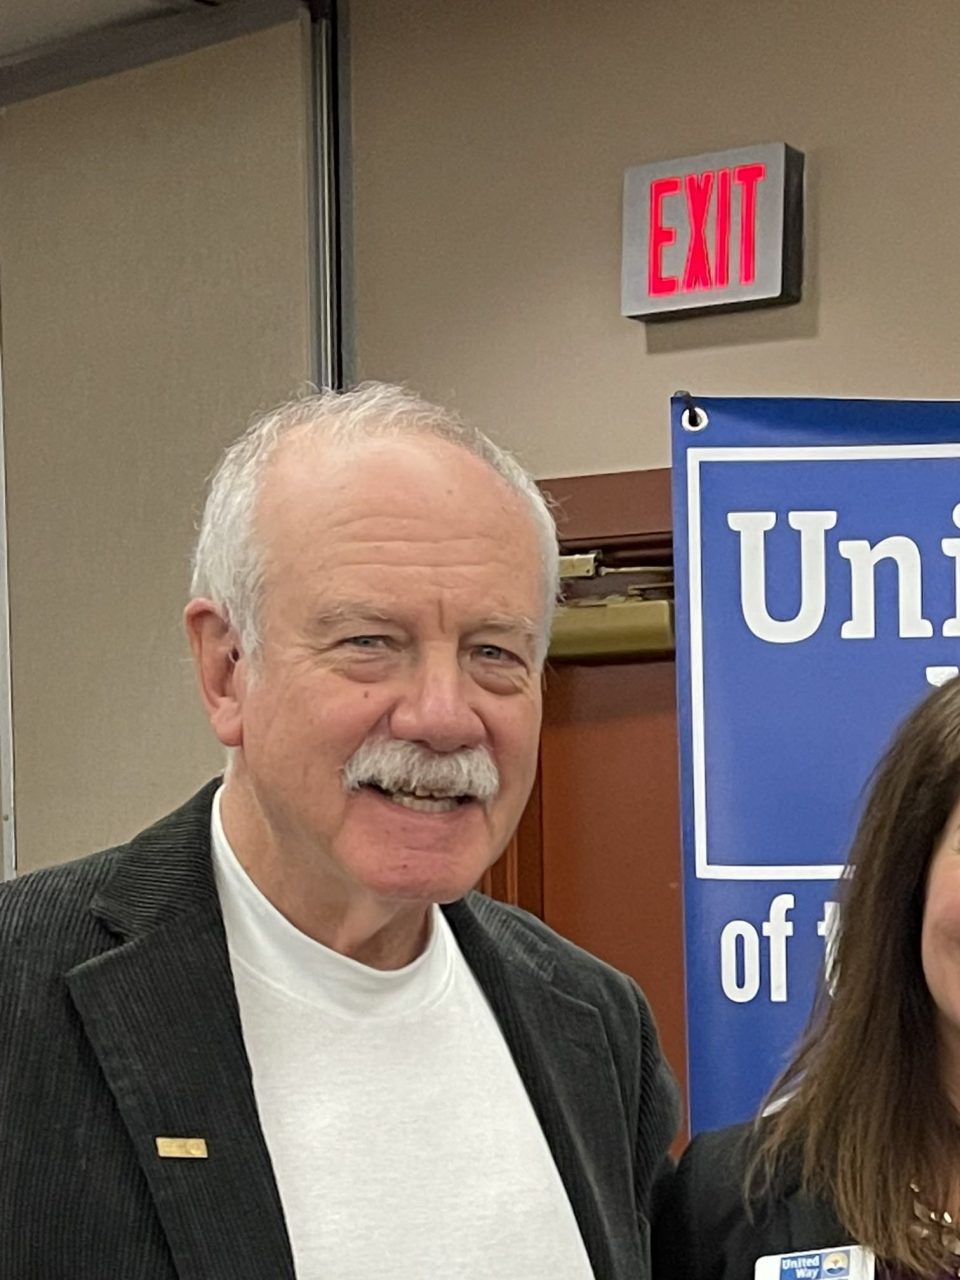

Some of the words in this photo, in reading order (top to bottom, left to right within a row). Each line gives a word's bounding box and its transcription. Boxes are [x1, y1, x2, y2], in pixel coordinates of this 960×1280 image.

[648, 163, 766, 297] EXIT
[719, 893, 795, 1003] of
[782, 1255, 820, 1270] United
[796, 1268, 819, 1280] Way
